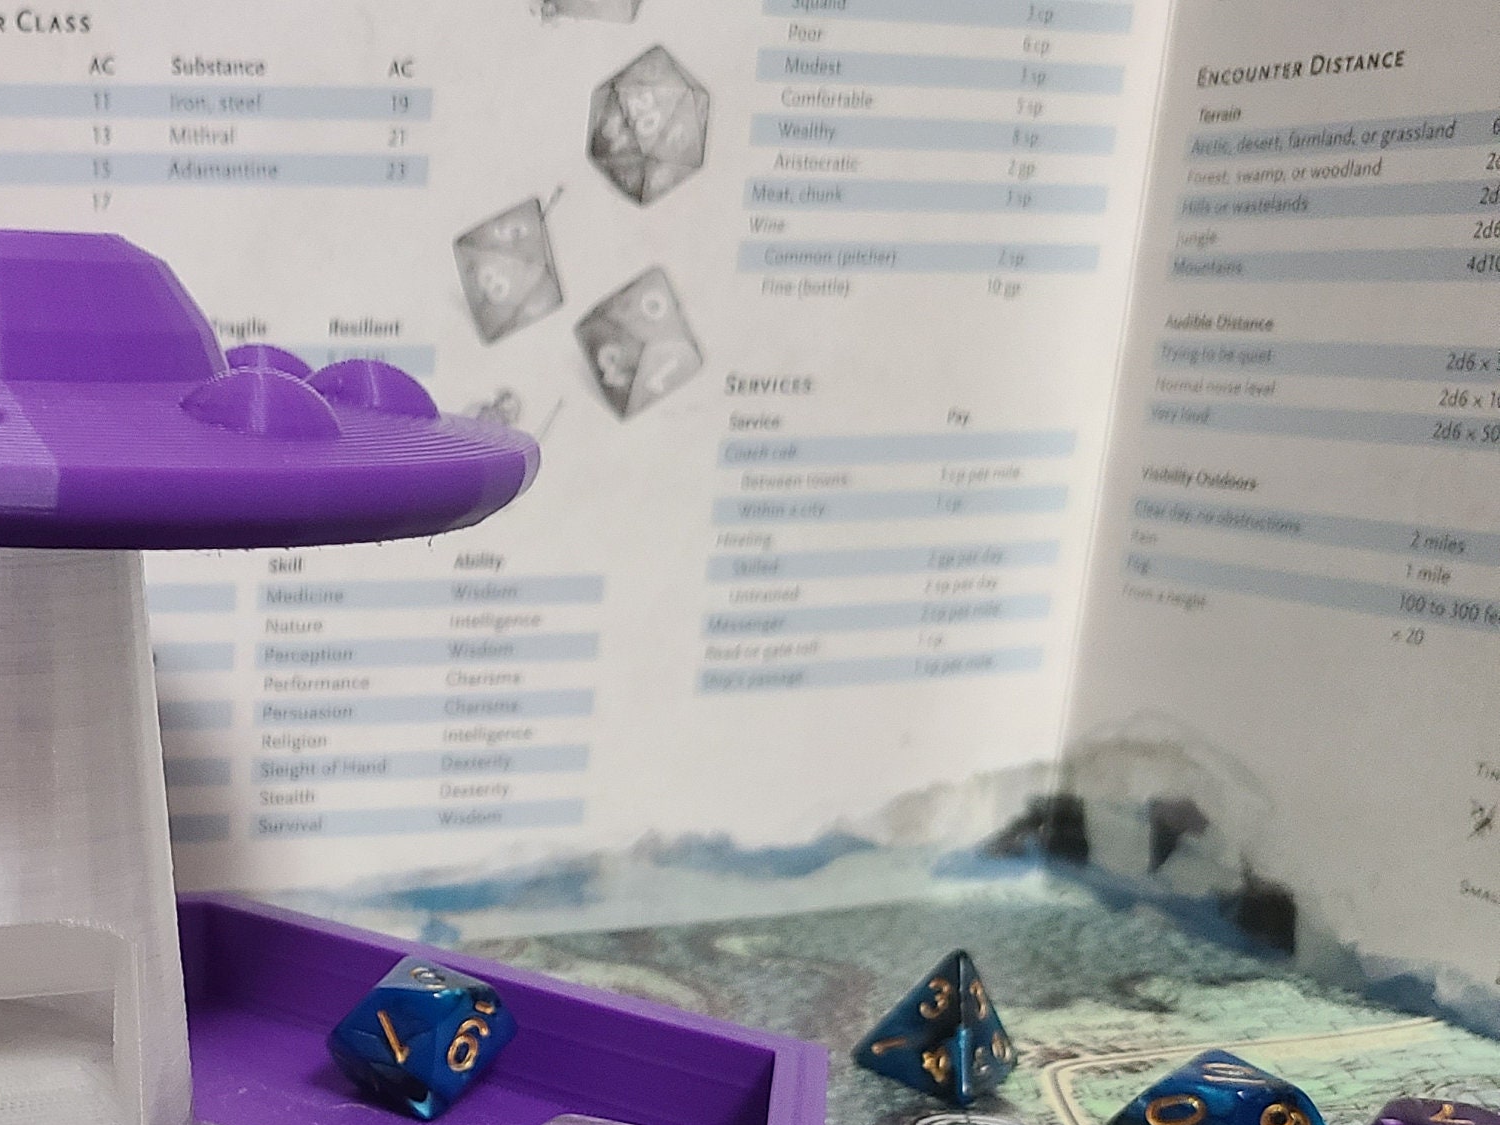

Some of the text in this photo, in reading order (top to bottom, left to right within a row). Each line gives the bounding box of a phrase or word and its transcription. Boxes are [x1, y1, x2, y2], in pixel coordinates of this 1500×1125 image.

[15, 7, 91, 34] CLASS
[1196, 48, 1406, 90] ENCOUNTER DISTANCE
